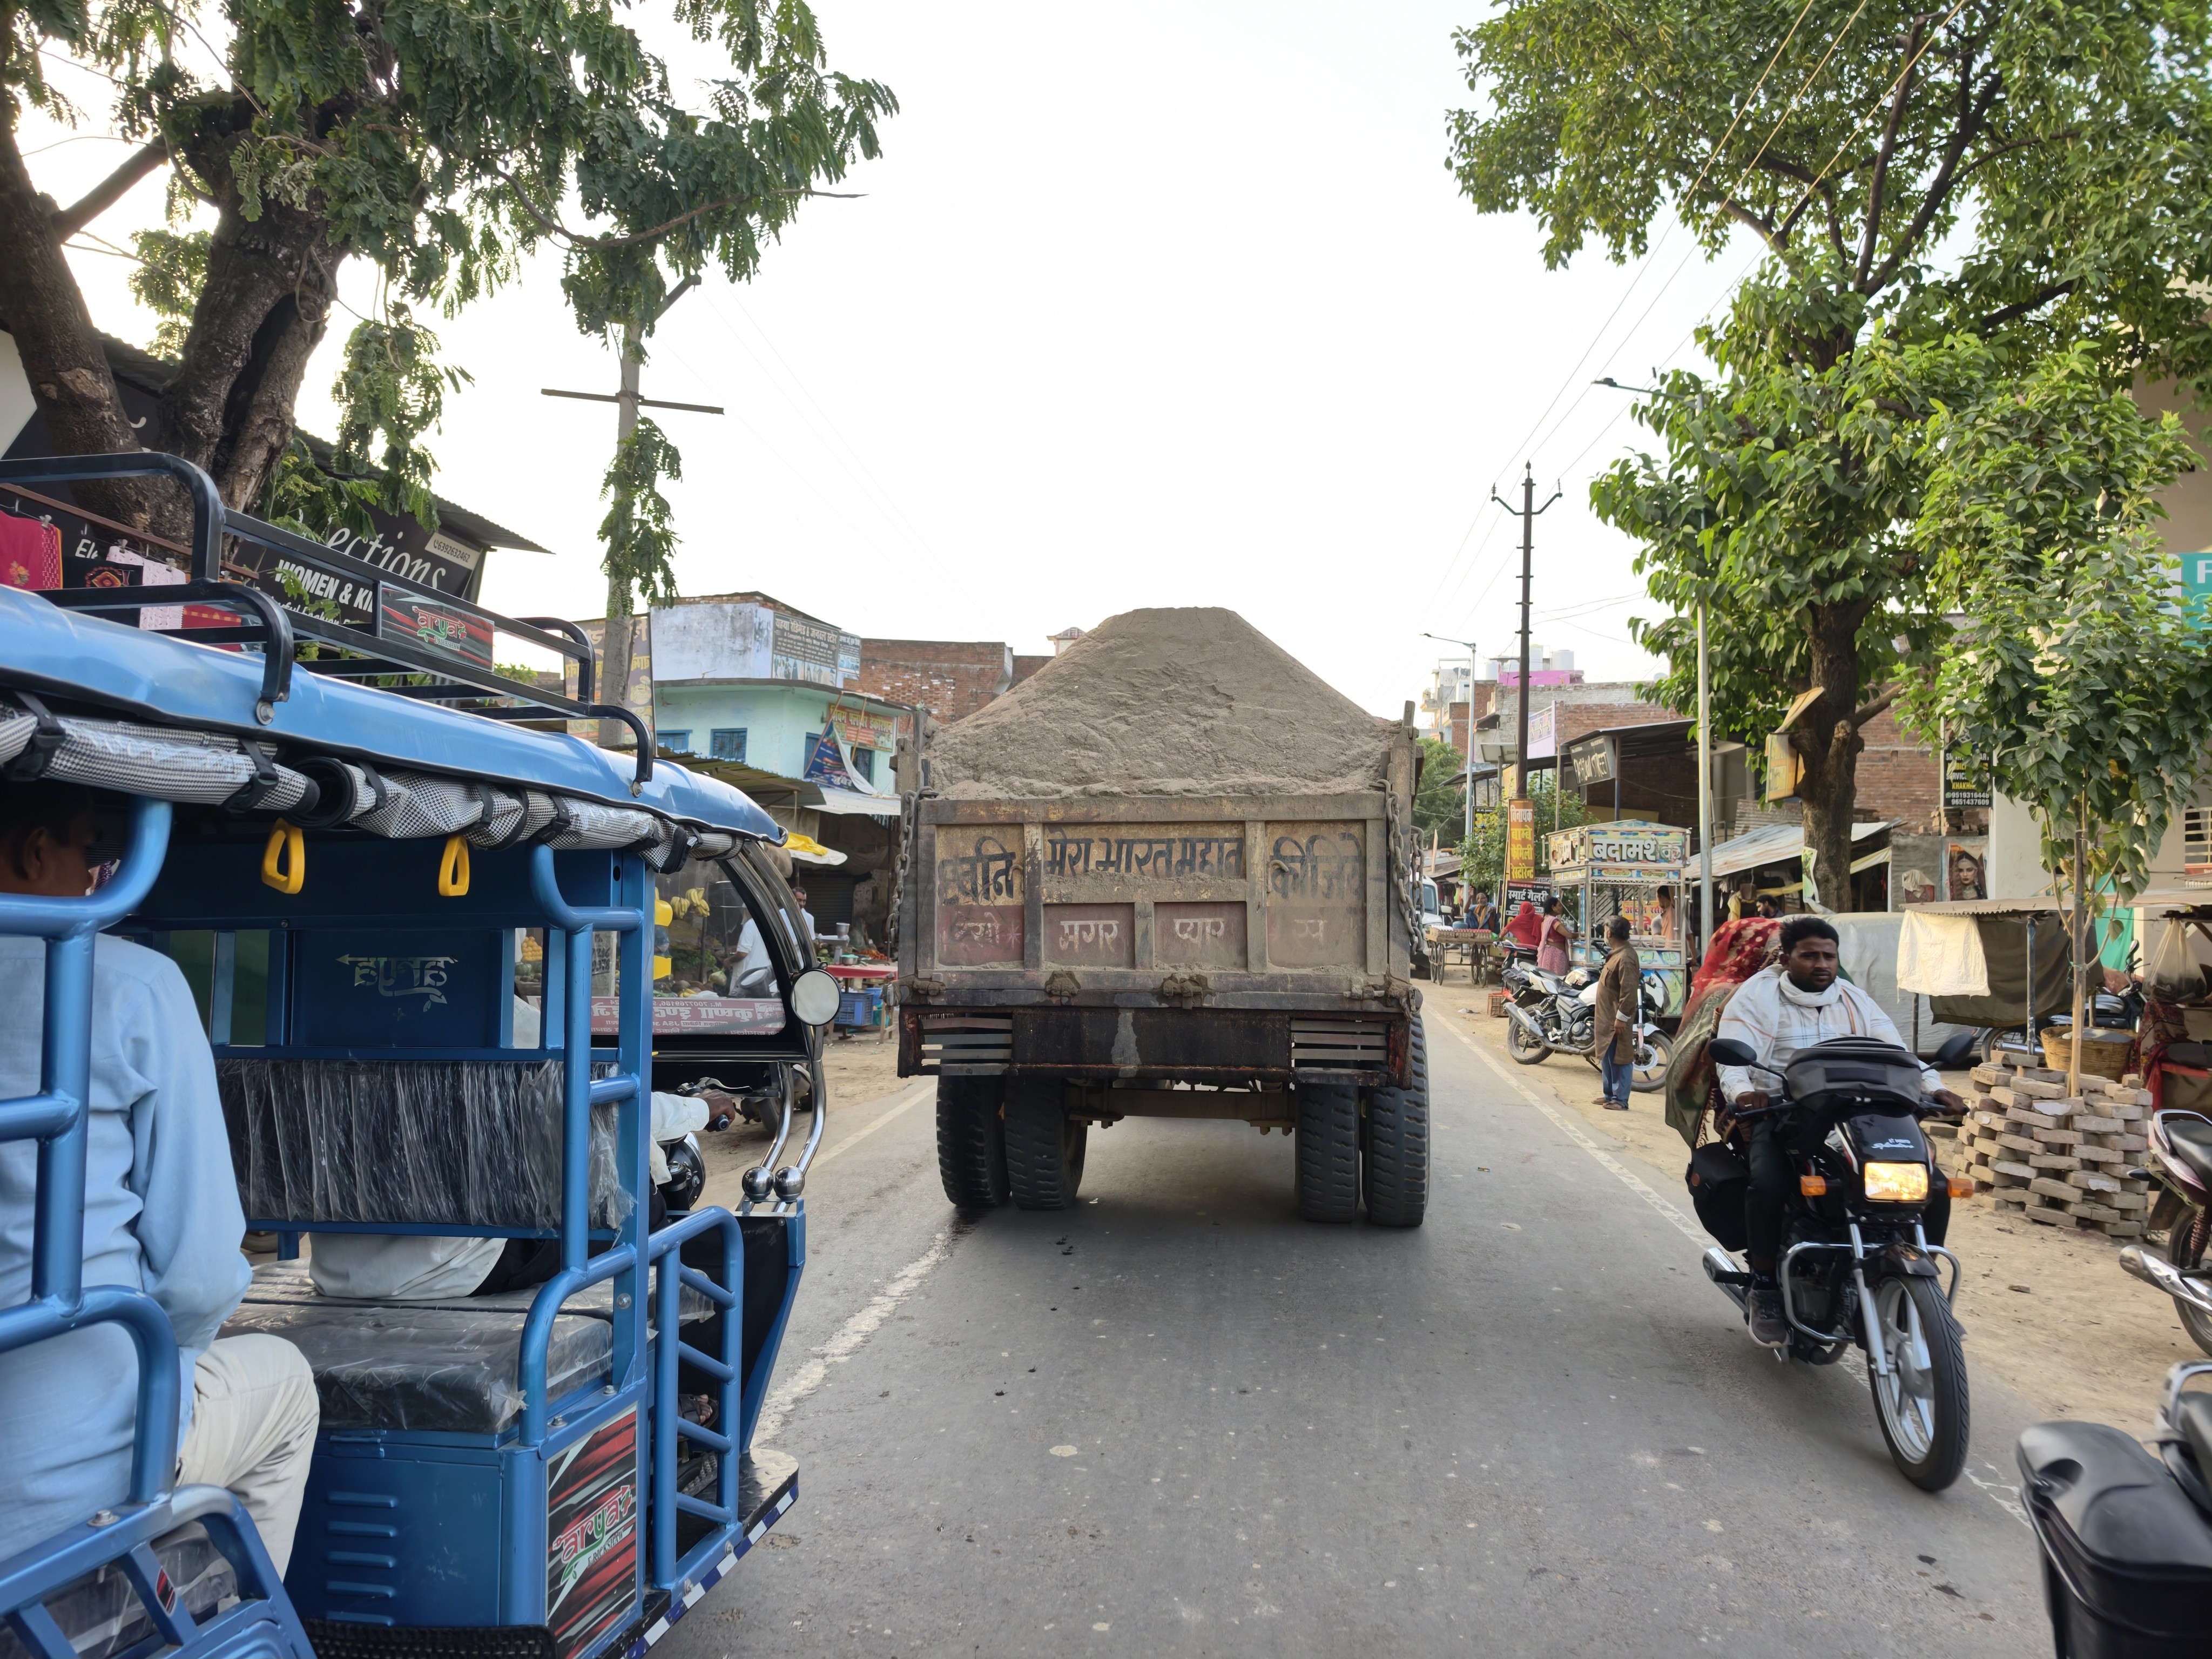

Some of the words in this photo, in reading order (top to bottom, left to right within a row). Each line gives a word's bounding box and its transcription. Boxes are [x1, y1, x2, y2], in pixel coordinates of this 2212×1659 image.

[437, 540, 471, 563] 6392632462
[274, 559, 340, 599] WOMEN
[339, 583, 353, 604] &
[417, 612, 458, 640] arya
[1510, 805, 1533, 822] विनायक
[1096, 837, 1176, 878] भारत
[1059, 919, 1120, 953] मगर
